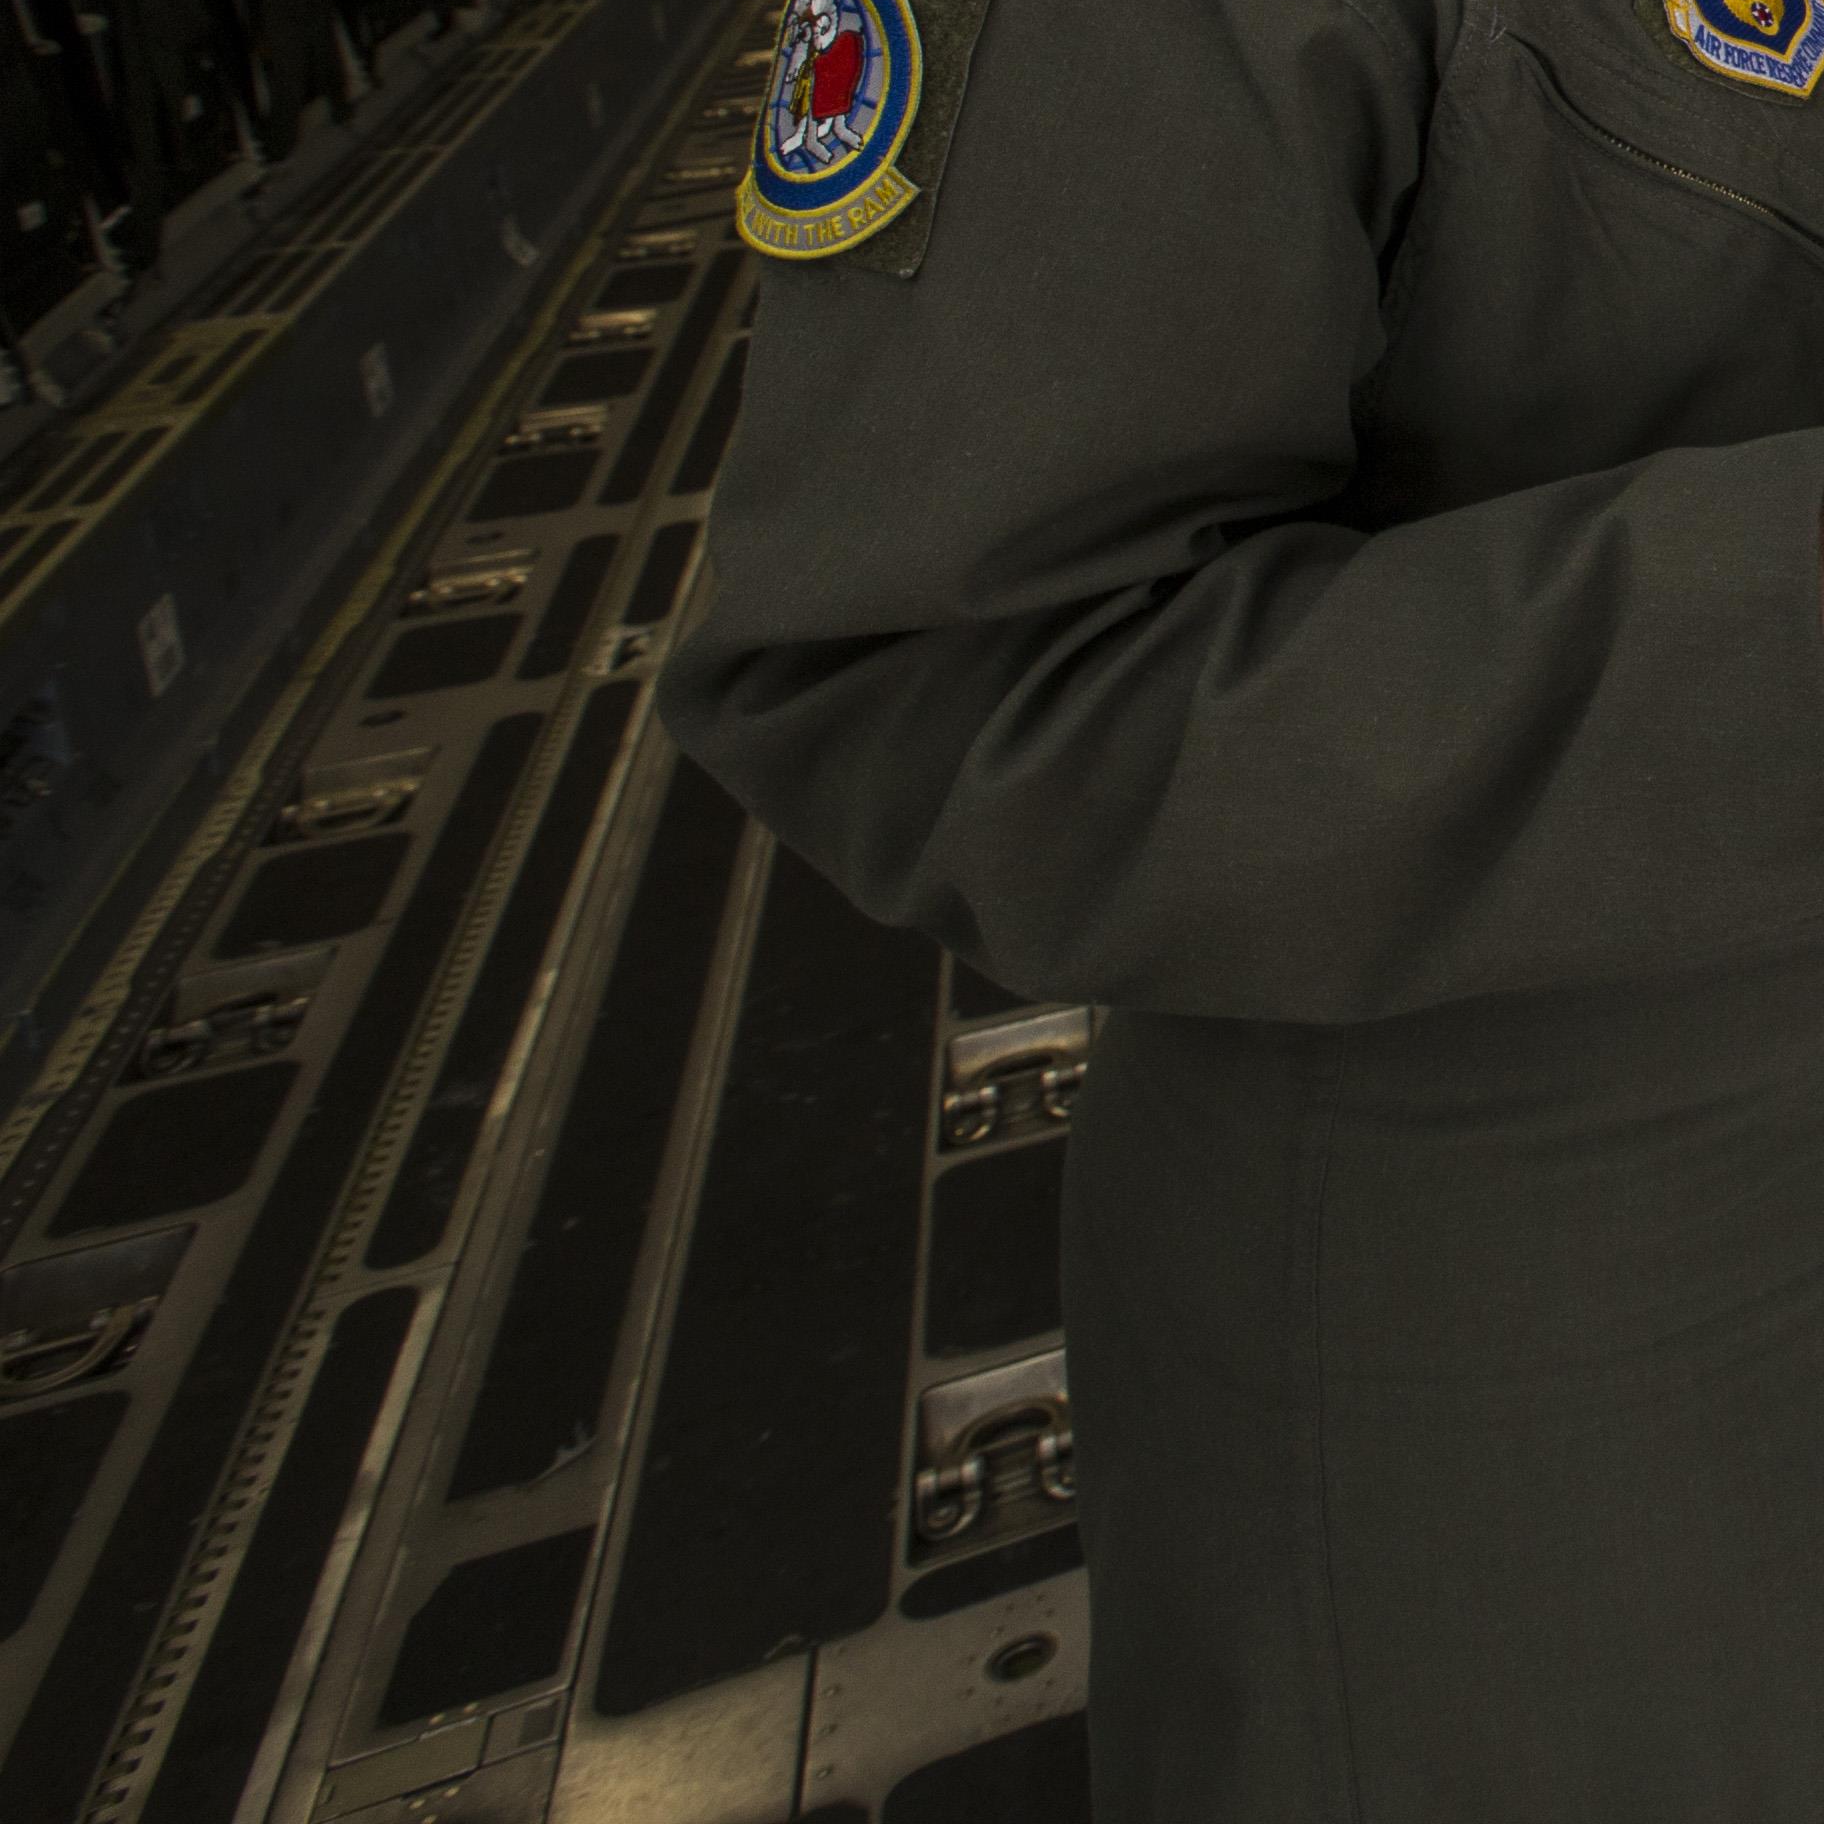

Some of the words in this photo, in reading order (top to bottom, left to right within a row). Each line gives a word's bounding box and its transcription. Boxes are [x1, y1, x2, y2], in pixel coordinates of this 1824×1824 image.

[1694, 24, 1721, 61] AIR
[1723, 41, 1767, 75] FORCE
[802, 215, 846, 246] THE
[846, 177, 900, 230] RAM
